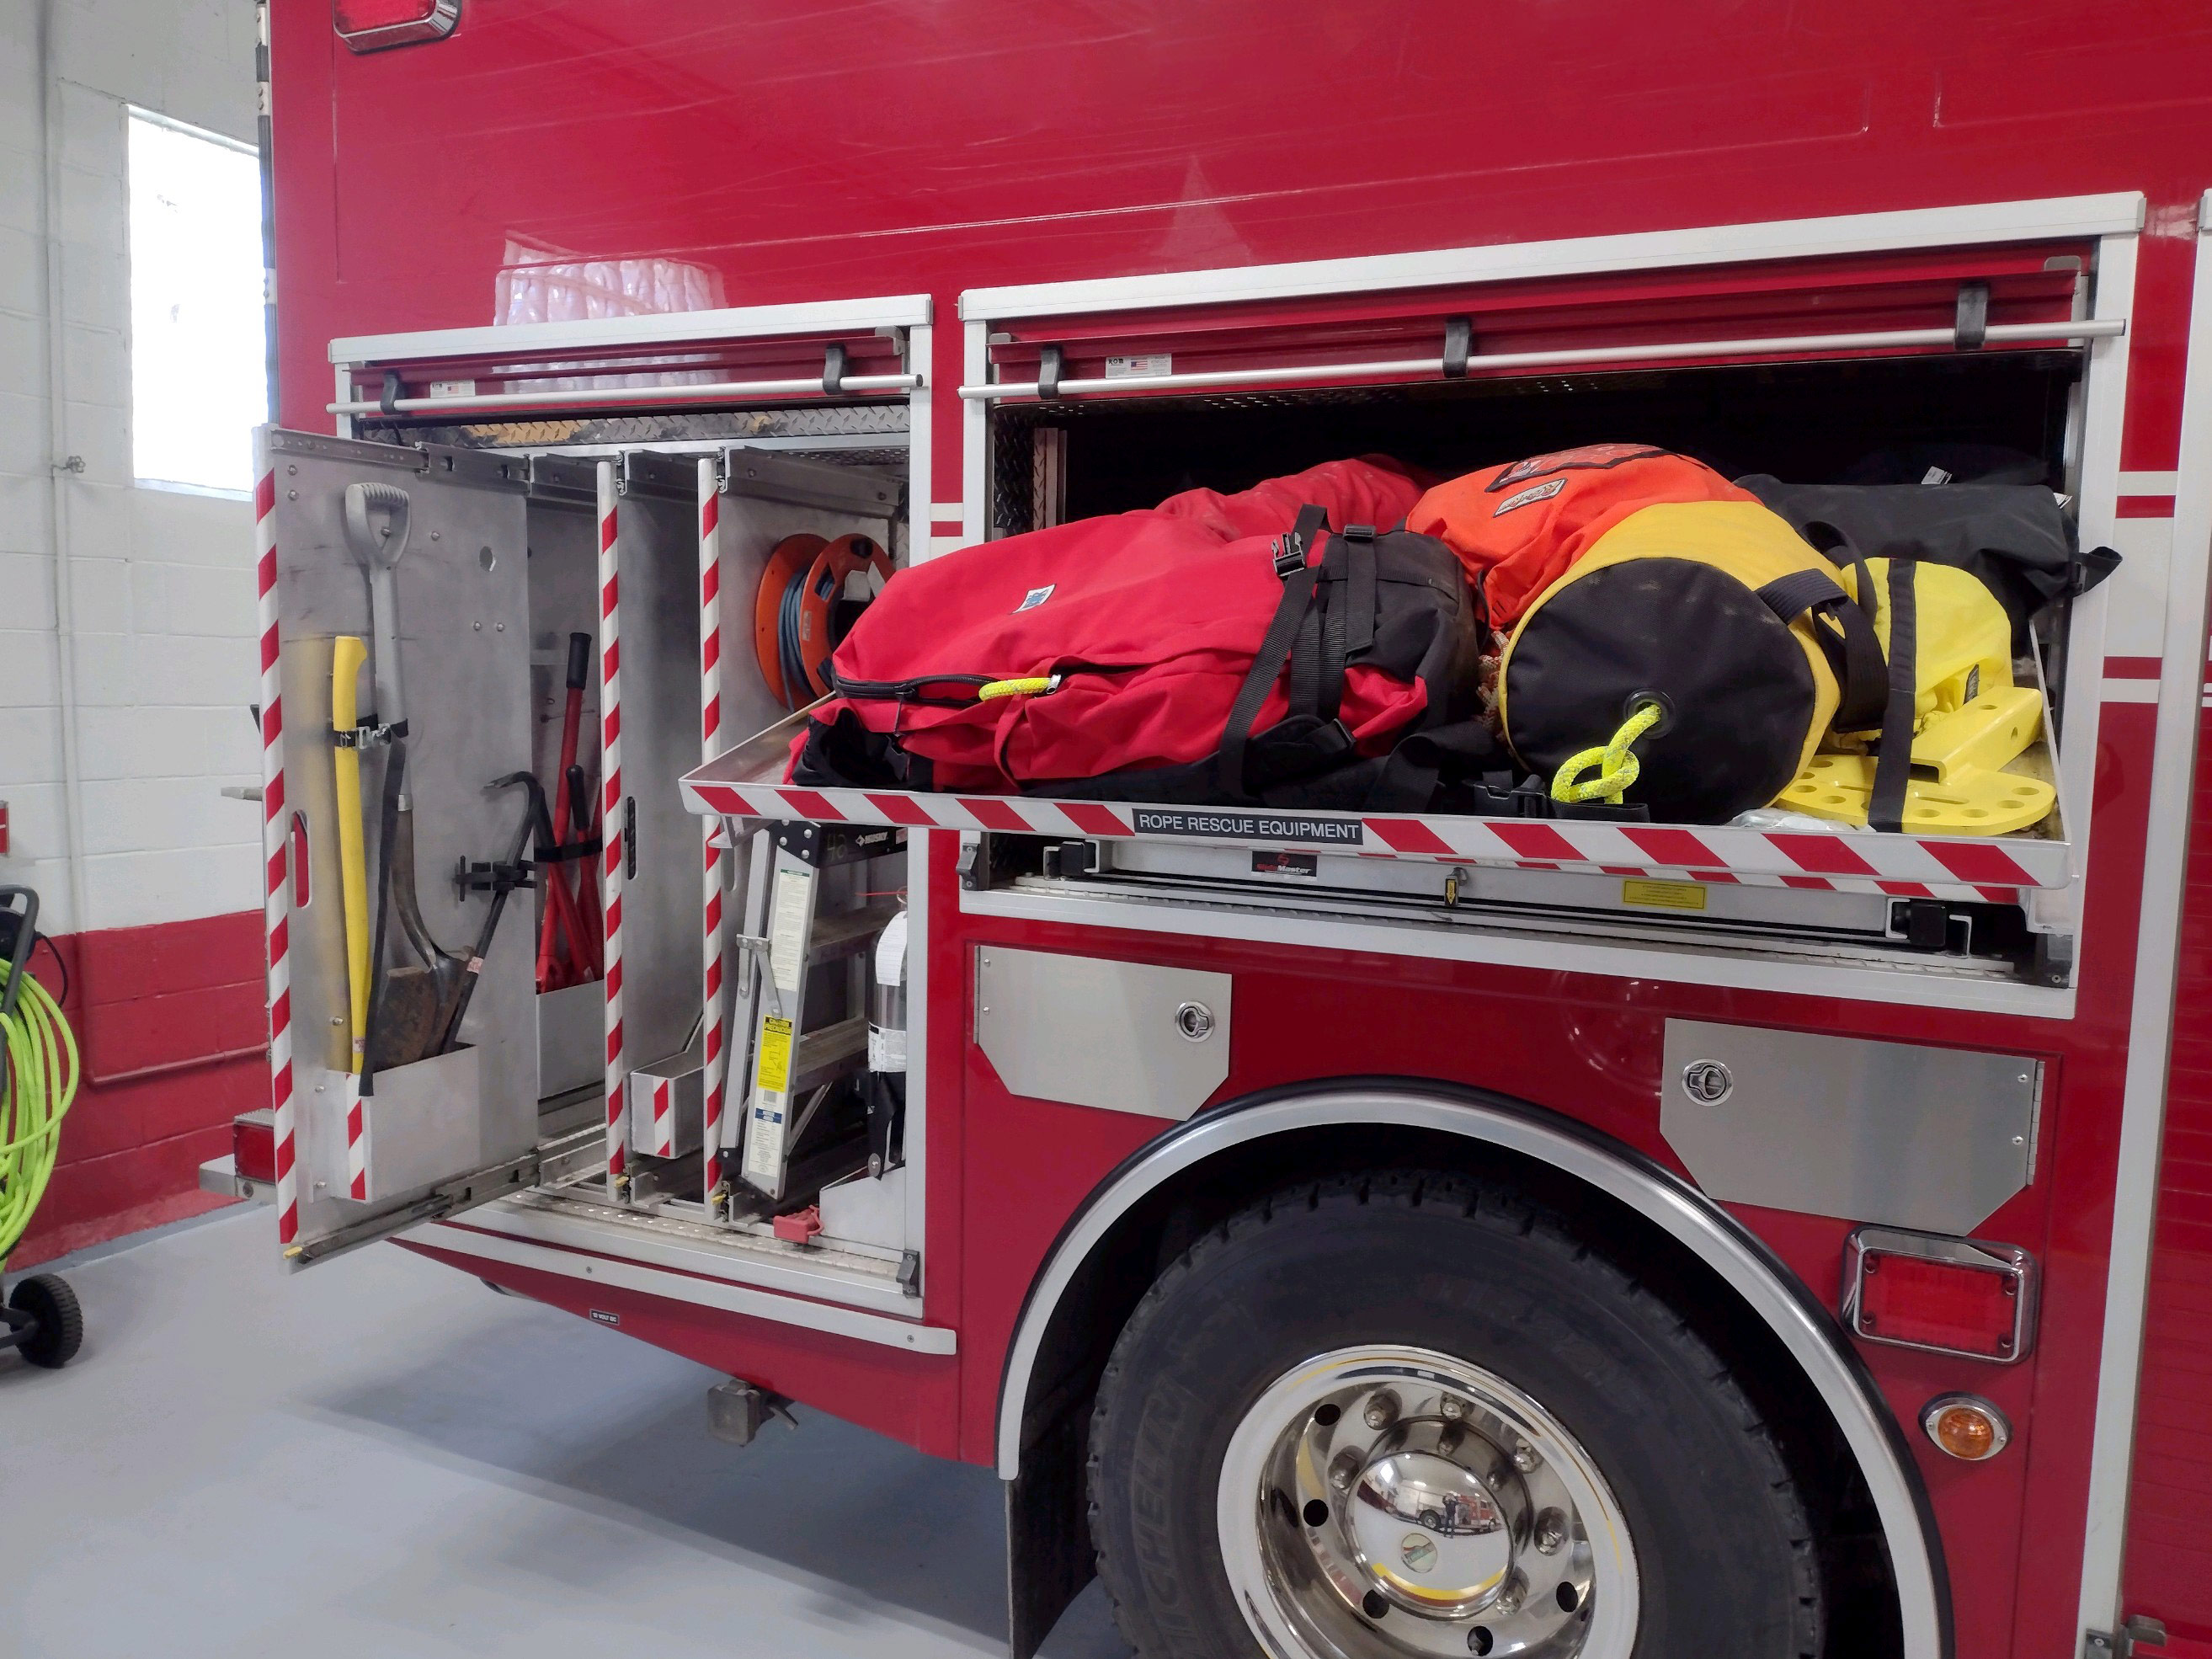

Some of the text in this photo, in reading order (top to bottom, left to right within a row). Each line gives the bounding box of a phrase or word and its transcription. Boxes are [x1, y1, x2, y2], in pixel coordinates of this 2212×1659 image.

[1139, 813, 1359, 839] ROPE RESCUE EQUIPMENT
